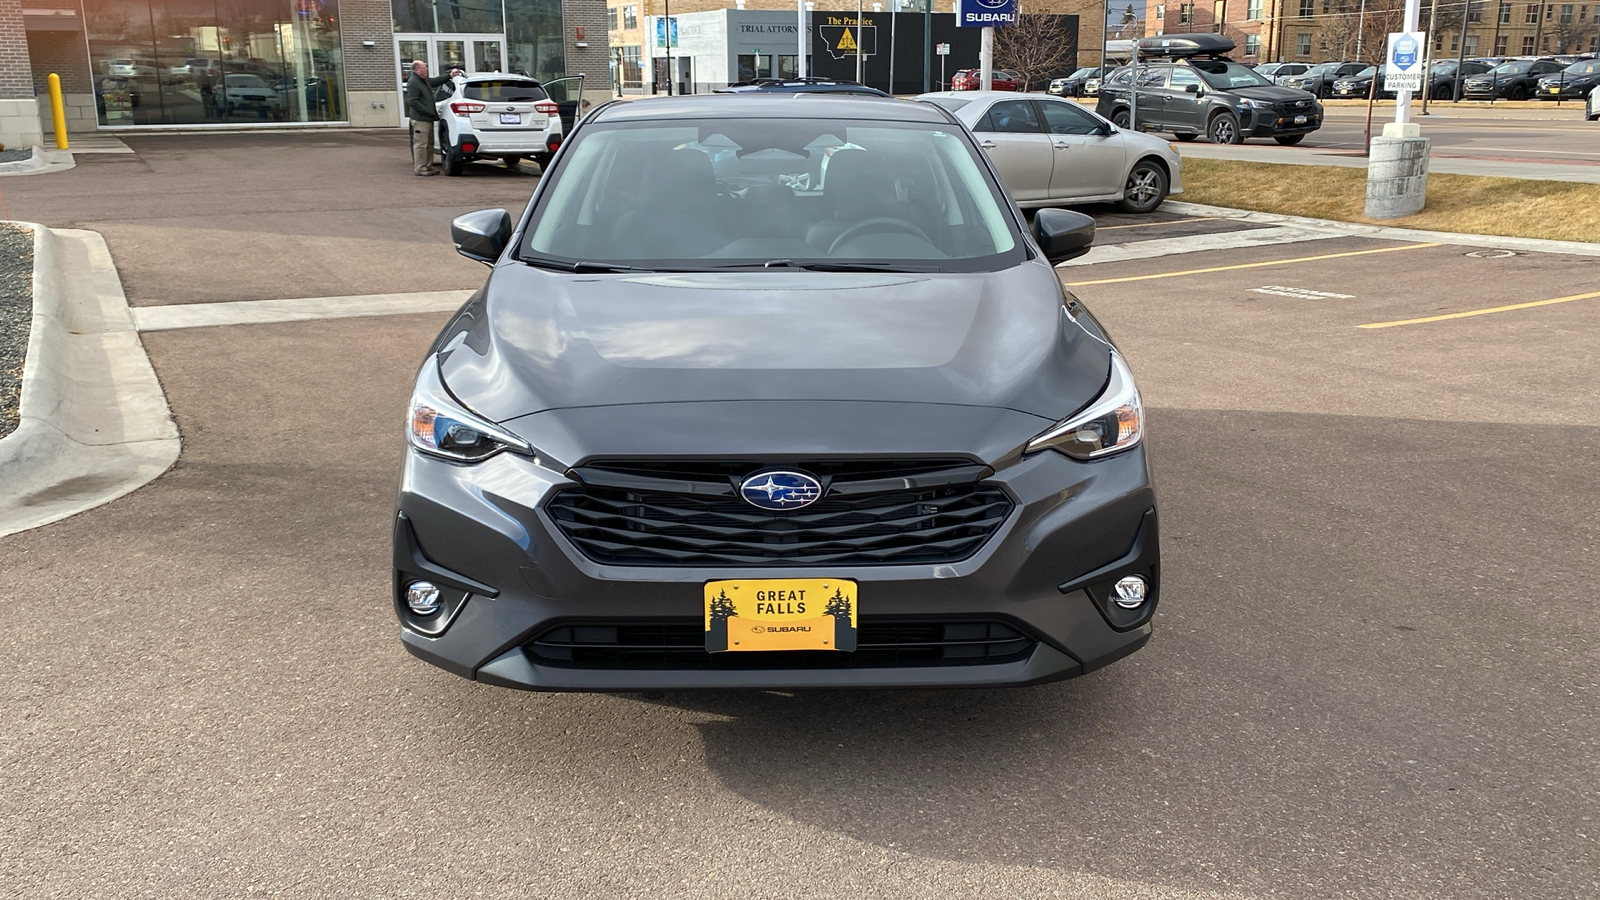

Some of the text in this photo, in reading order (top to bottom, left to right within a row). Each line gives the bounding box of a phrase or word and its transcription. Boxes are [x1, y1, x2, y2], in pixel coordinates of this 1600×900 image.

[826, 16, 873, 25] The Praice
[966, 13, 1015, 22] SUBARU
[740, 24, 812, 33] TRIAL ATTORNS
[756, 590, 806, 601] GREAT
[757, 602, 806, 614] FALLS
